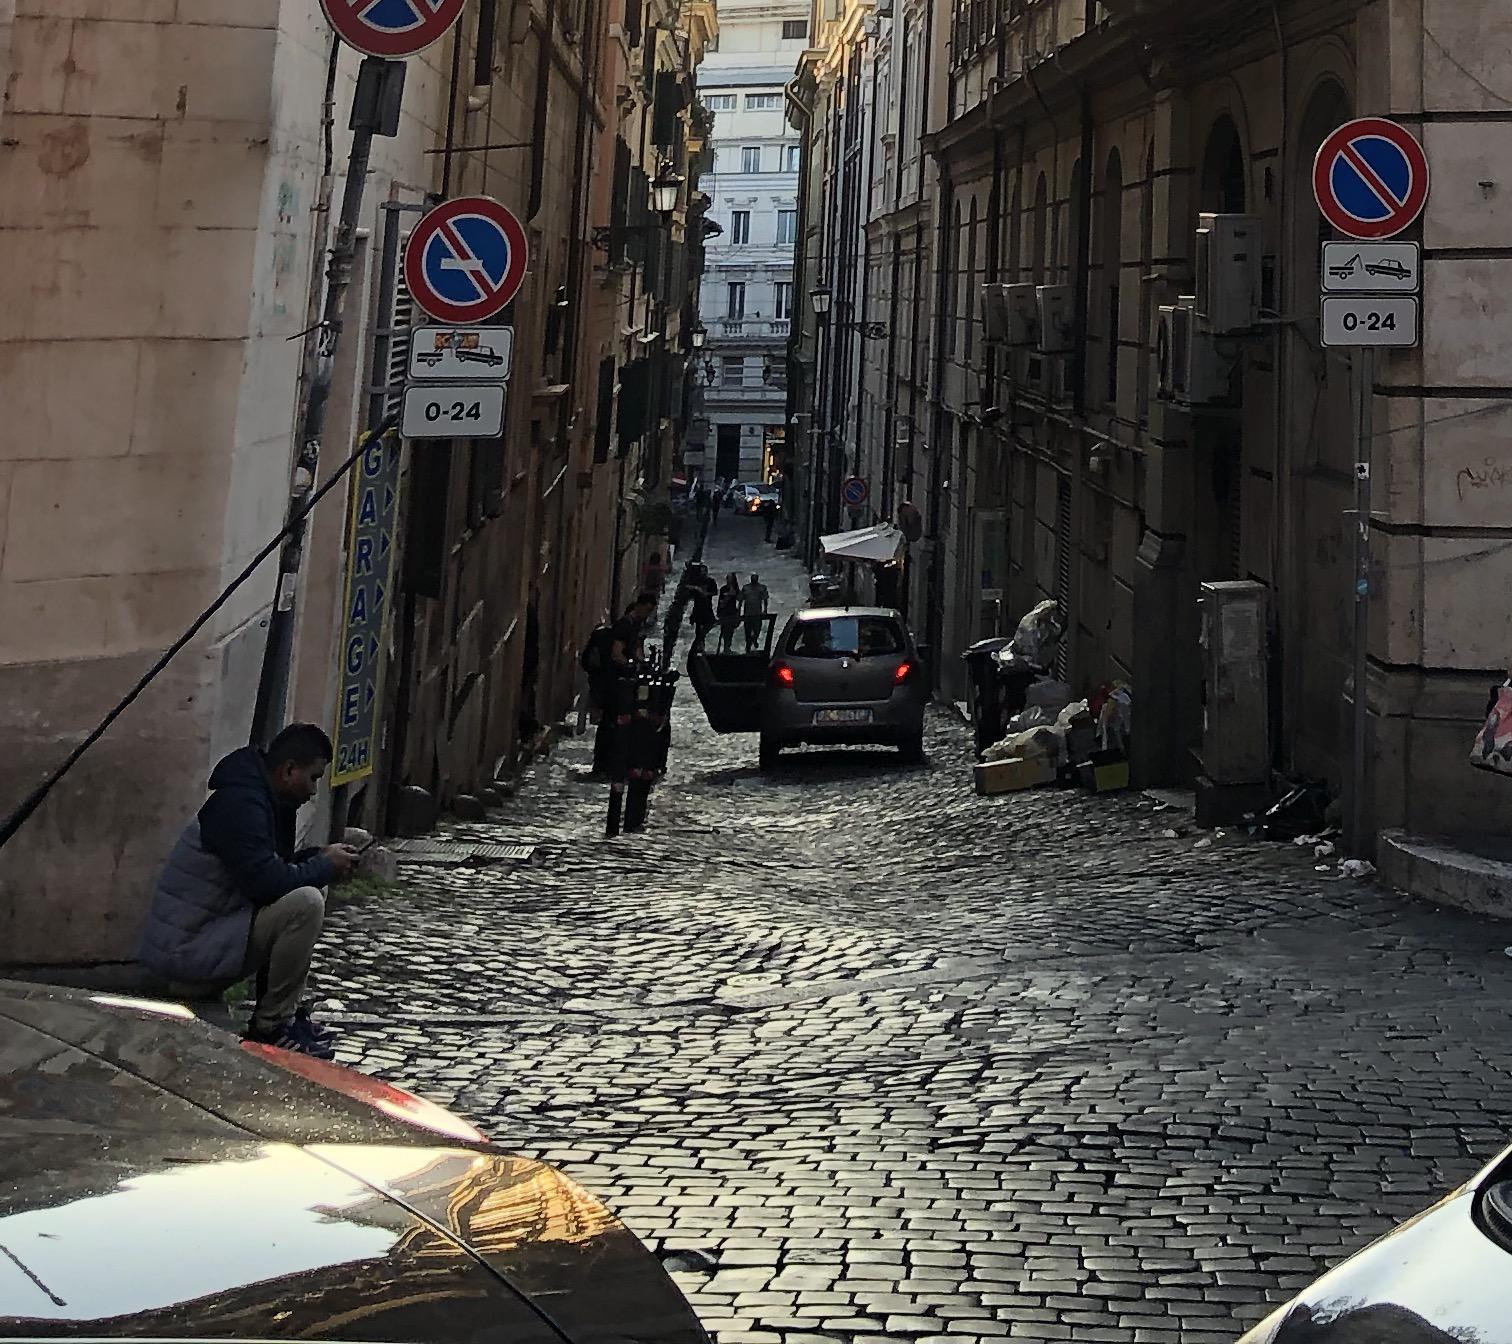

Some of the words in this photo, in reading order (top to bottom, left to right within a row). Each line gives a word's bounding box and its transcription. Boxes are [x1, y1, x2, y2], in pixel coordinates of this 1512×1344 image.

[1342, 312, 1396, 331] 0-24
[425, 401, 481, 422] 0-24
[343, 439, 382, 729] GARAGE
[337, 743, 371, 776] 24H
